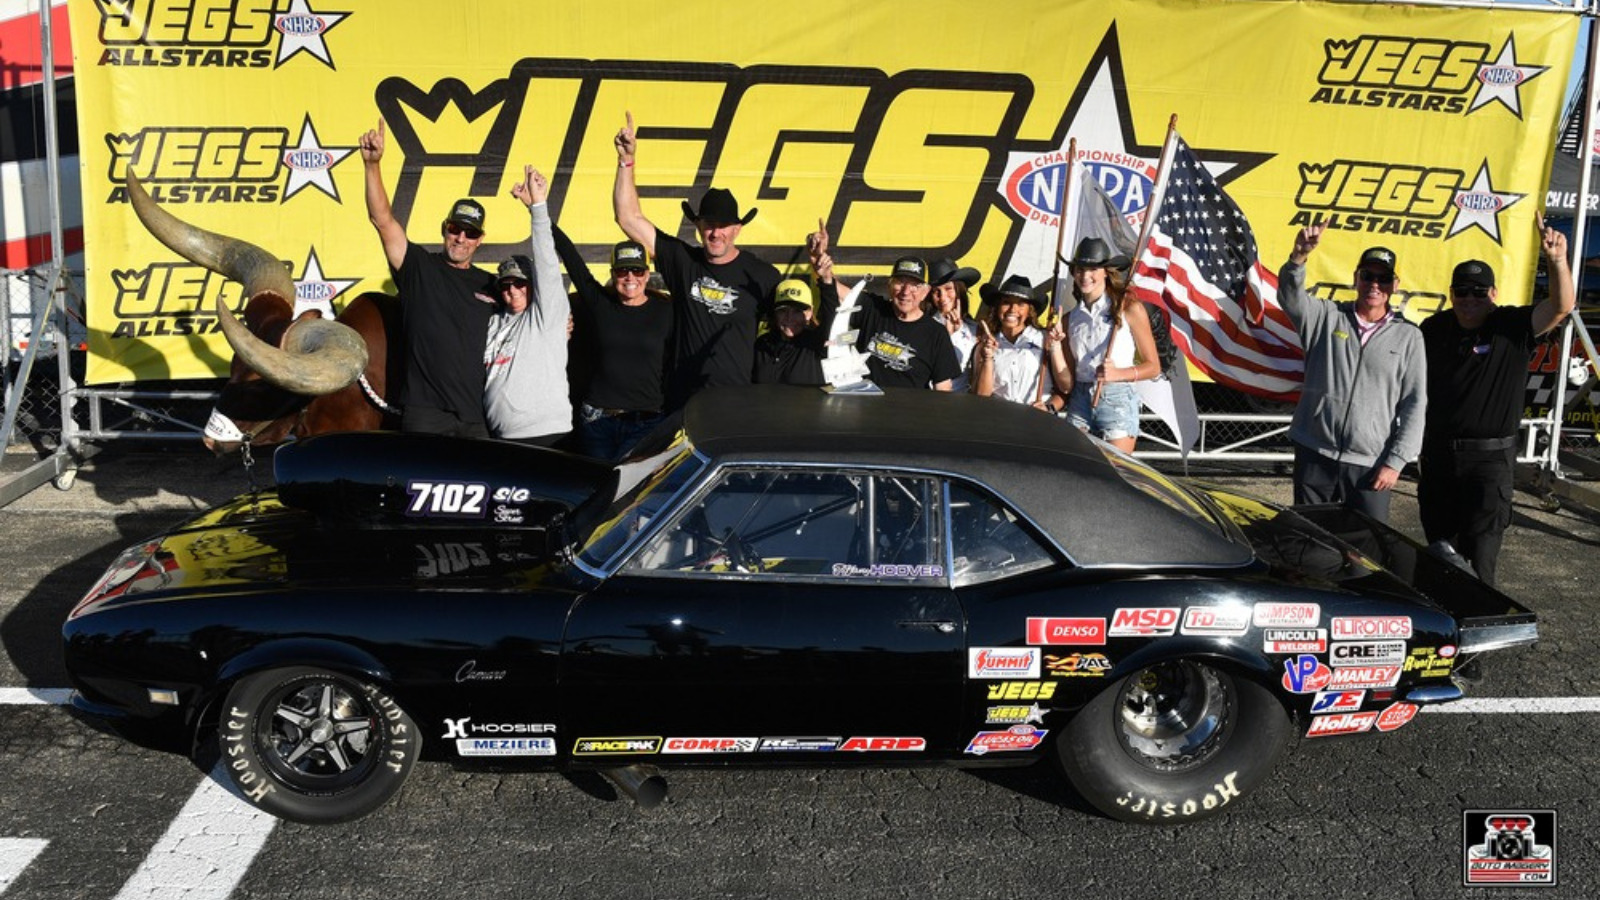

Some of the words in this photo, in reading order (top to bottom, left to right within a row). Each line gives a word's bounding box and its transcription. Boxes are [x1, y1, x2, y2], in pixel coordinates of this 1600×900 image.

[97, 0, 284, 46] JEGS
[281, 16, 323, 34] NHRA
[97, 48, 272, 68] ALLSTARS
[1317, 35, 1491, 94] JEGS
[1485, 67, 1520, 84] NHRA
[1309, 87, 1468, 114] ALLSTARS
[107, 127, 290, 183] JEGS
[289, 150, 331, 169] NHRA
[385, 58, 1036, 267] JEGS
[106, 184, 279, 205] ALSTARS
[1294, 159, 1465, 219] JEGS
[1462, 193, 1496, 209] NHRA
[1288, 210, 1446, 239] ALLSTARS
[410, 482, 486, 514] 7102
[871, 564, 943, 577] HOOVER
[1114, 609, 1177, 627] MSD
[1259, 606, 1315, 619] SIMPSON
[1053, 626, 1099, 637] DENSO
[1268, 630, 1316, 641] LINCOLN
[1278, 642, 1320, 652] WELDERS
[1334, 645, 1376, 659] CRE
[456, 660, 507, 683] Camaro
[1284, 654, 1318, 692] VP
[1334, 668, 1392, 682] MANLEY
[987, 681, 1058, 700] JEGS
[1312, 691, 1362, 711] JE
[989, 707, 1030, 719] JEGS
[471, 723, 557, 733] HOOSIER
[1313, 713, 1375, 732] Holley
[474, 740, 551, 749] MEZIERE
[592, 740, 655, 751] RACEPAK
[668, 739, 735, 750] COMP
[840, 737, 923, 750] ARP
[1116, 770, 1241, 818] Hoosier
